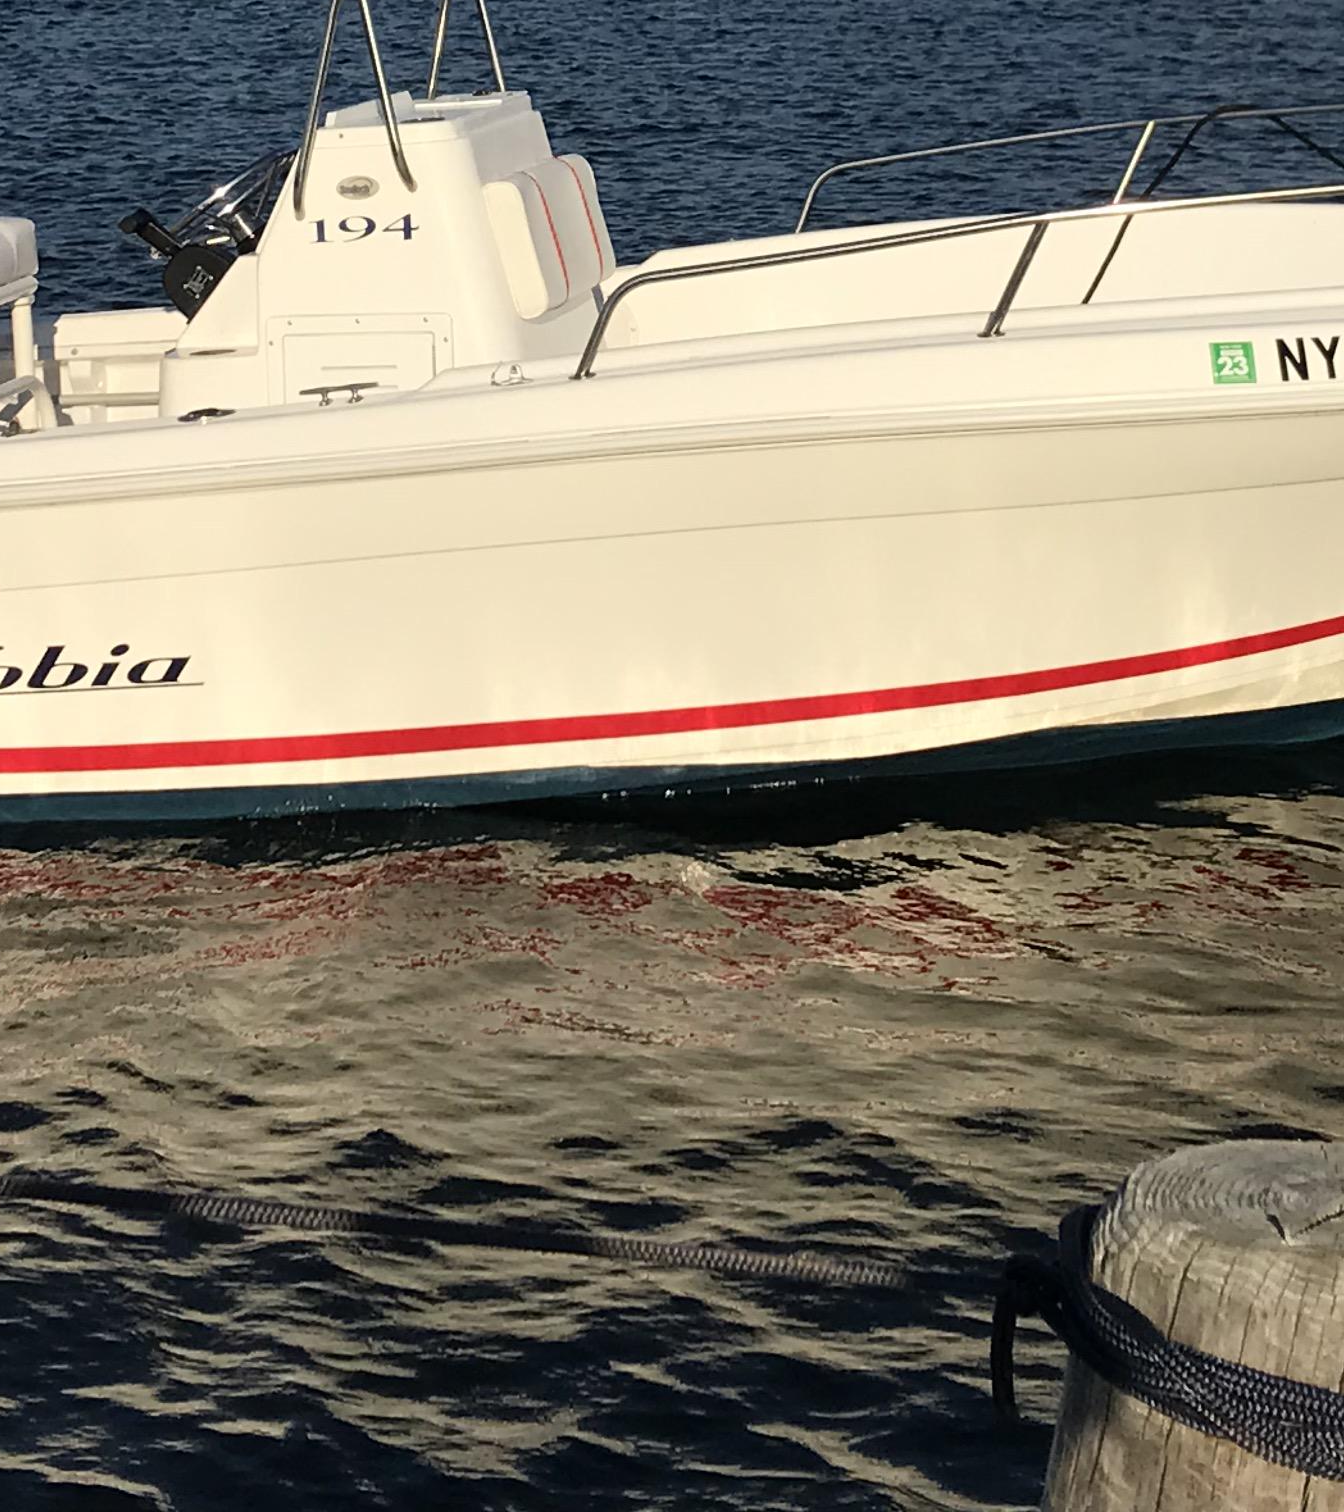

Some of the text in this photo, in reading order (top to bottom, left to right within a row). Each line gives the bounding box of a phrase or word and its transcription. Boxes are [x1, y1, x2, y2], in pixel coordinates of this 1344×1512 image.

[308, 213, 420, 244] 194
[1216, 356, 1249, 376] 23
[1275, 336, 1340, 381] NY
